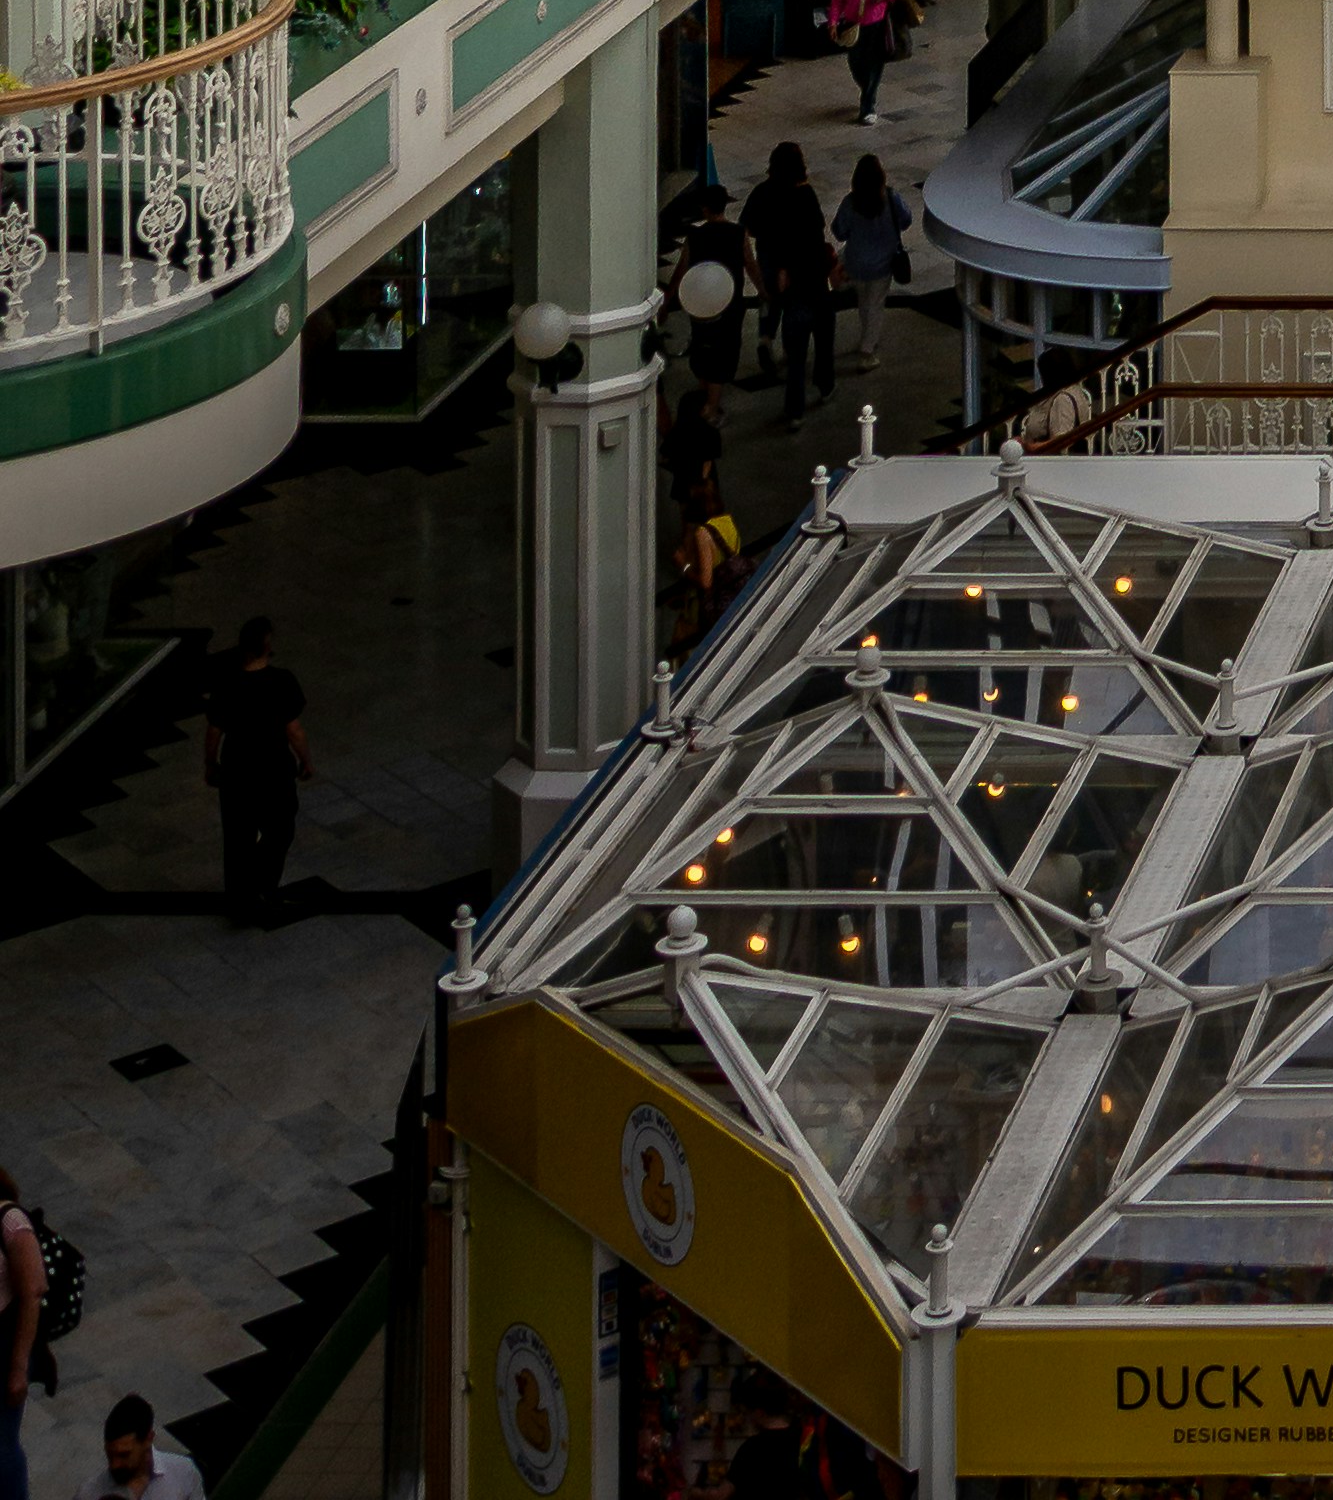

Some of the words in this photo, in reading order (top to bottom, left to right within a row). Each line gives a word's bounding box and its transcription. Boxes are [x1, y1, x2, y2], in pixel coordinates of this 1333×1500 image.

[655, 1115, 686, 1166] WORLD
[1115, 1364, 1264, 1410] DUCK
[1173, 1426, 1271, 1444] DESIGNER
